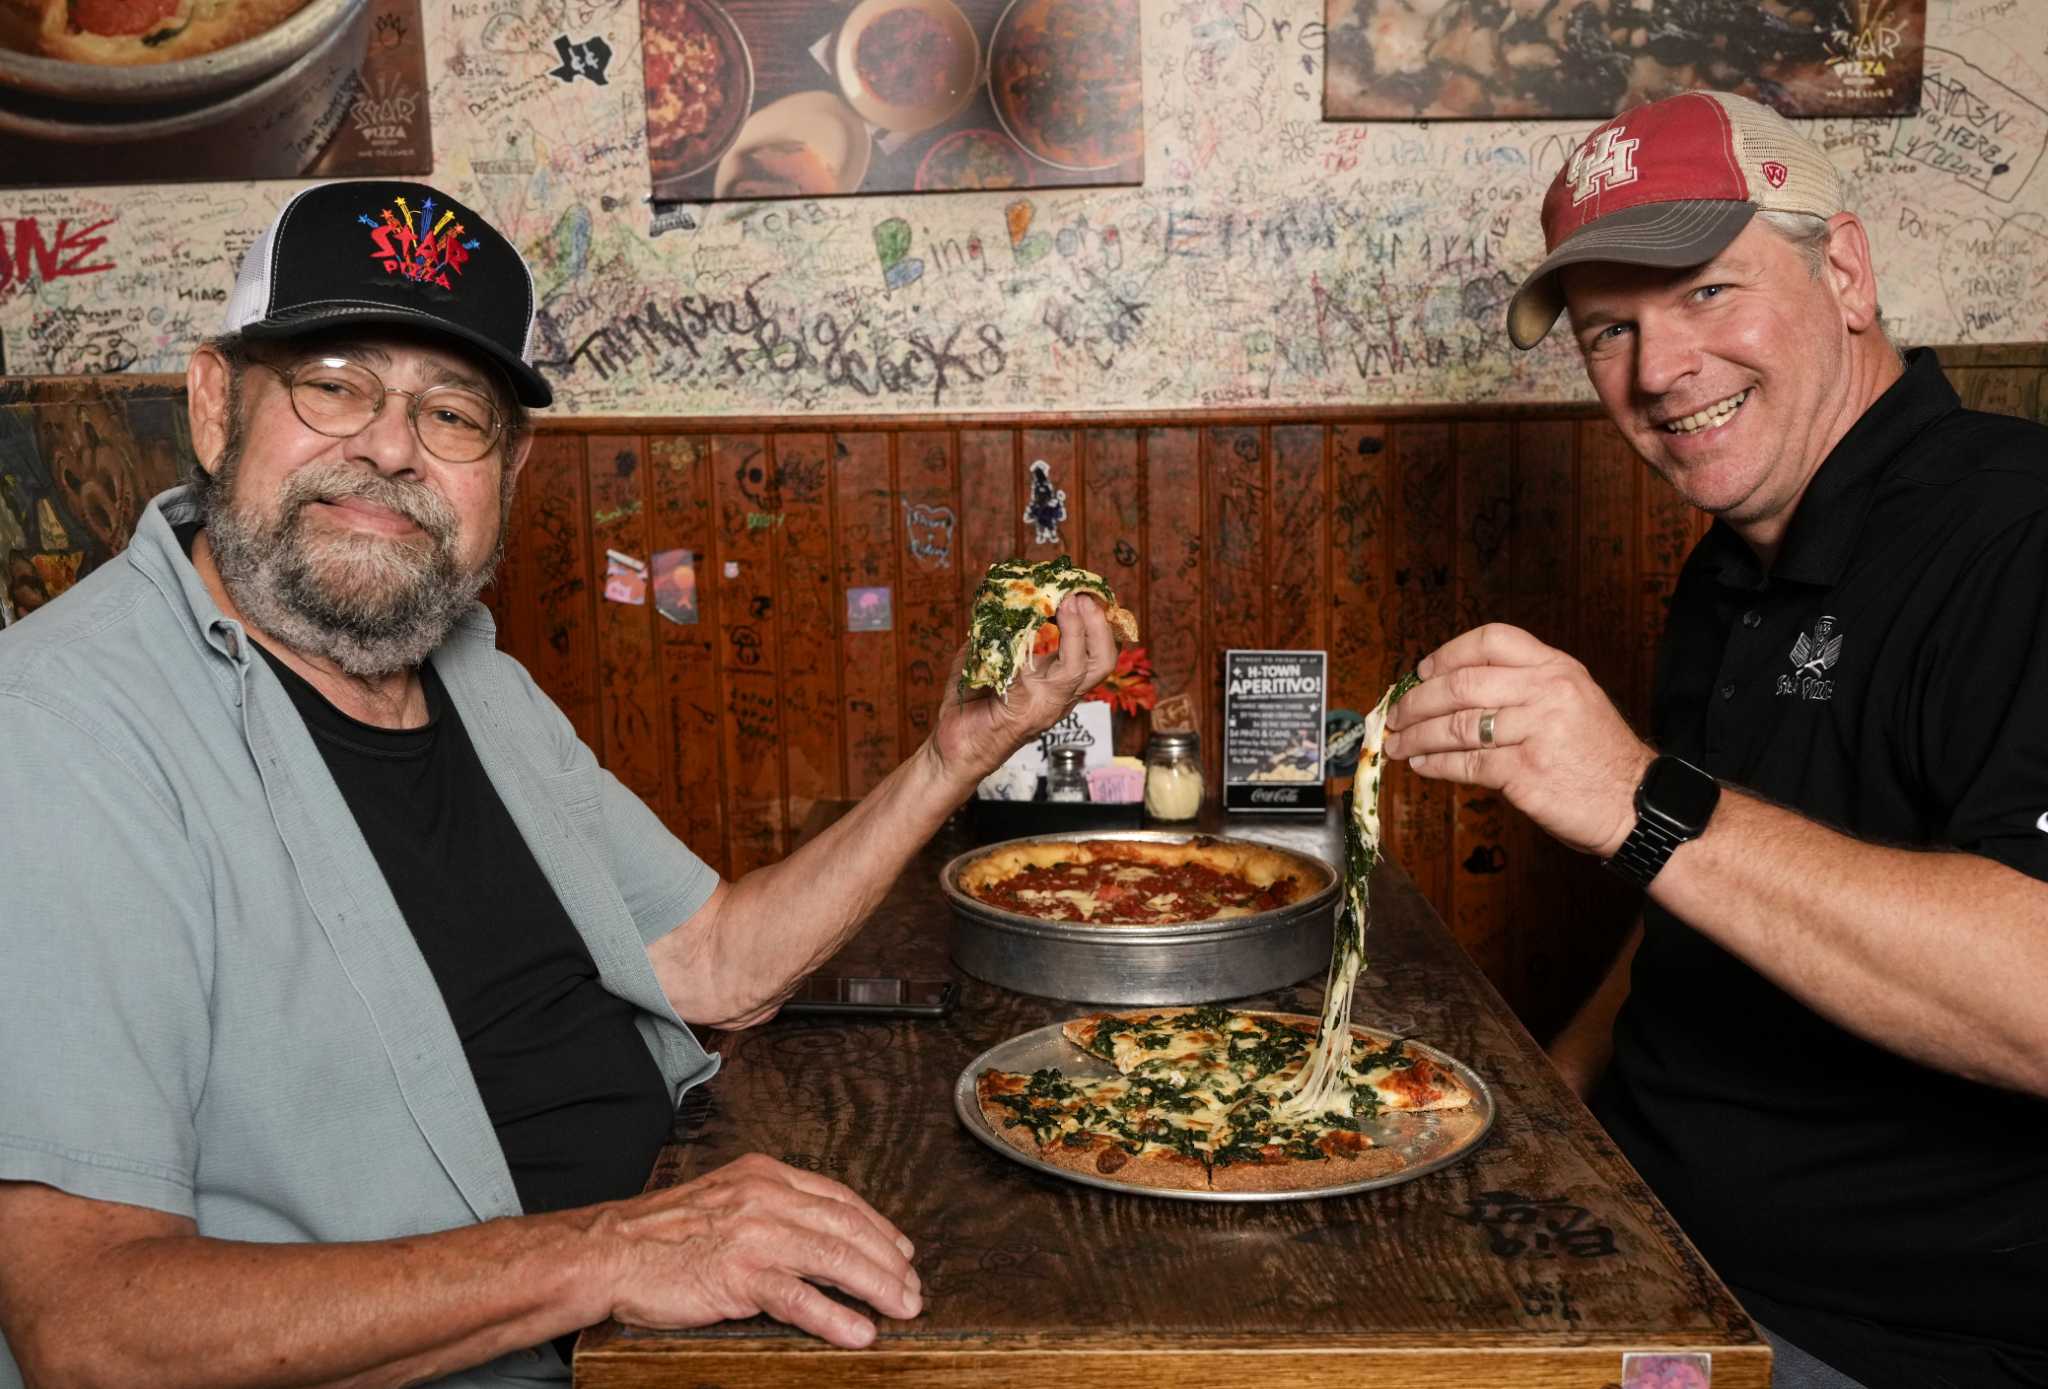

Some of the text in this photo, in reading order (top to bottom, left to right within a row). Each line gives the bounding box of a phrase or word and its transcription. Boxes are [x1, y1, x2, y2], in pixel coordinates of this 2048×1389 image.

[369, 223, 469, 276] STAR
[383, 259, 452, 291] PIZZA
[1247, 665, 1301, 678] H-TOWN
[1229, 677, 1321, 695] APERITIVO!
